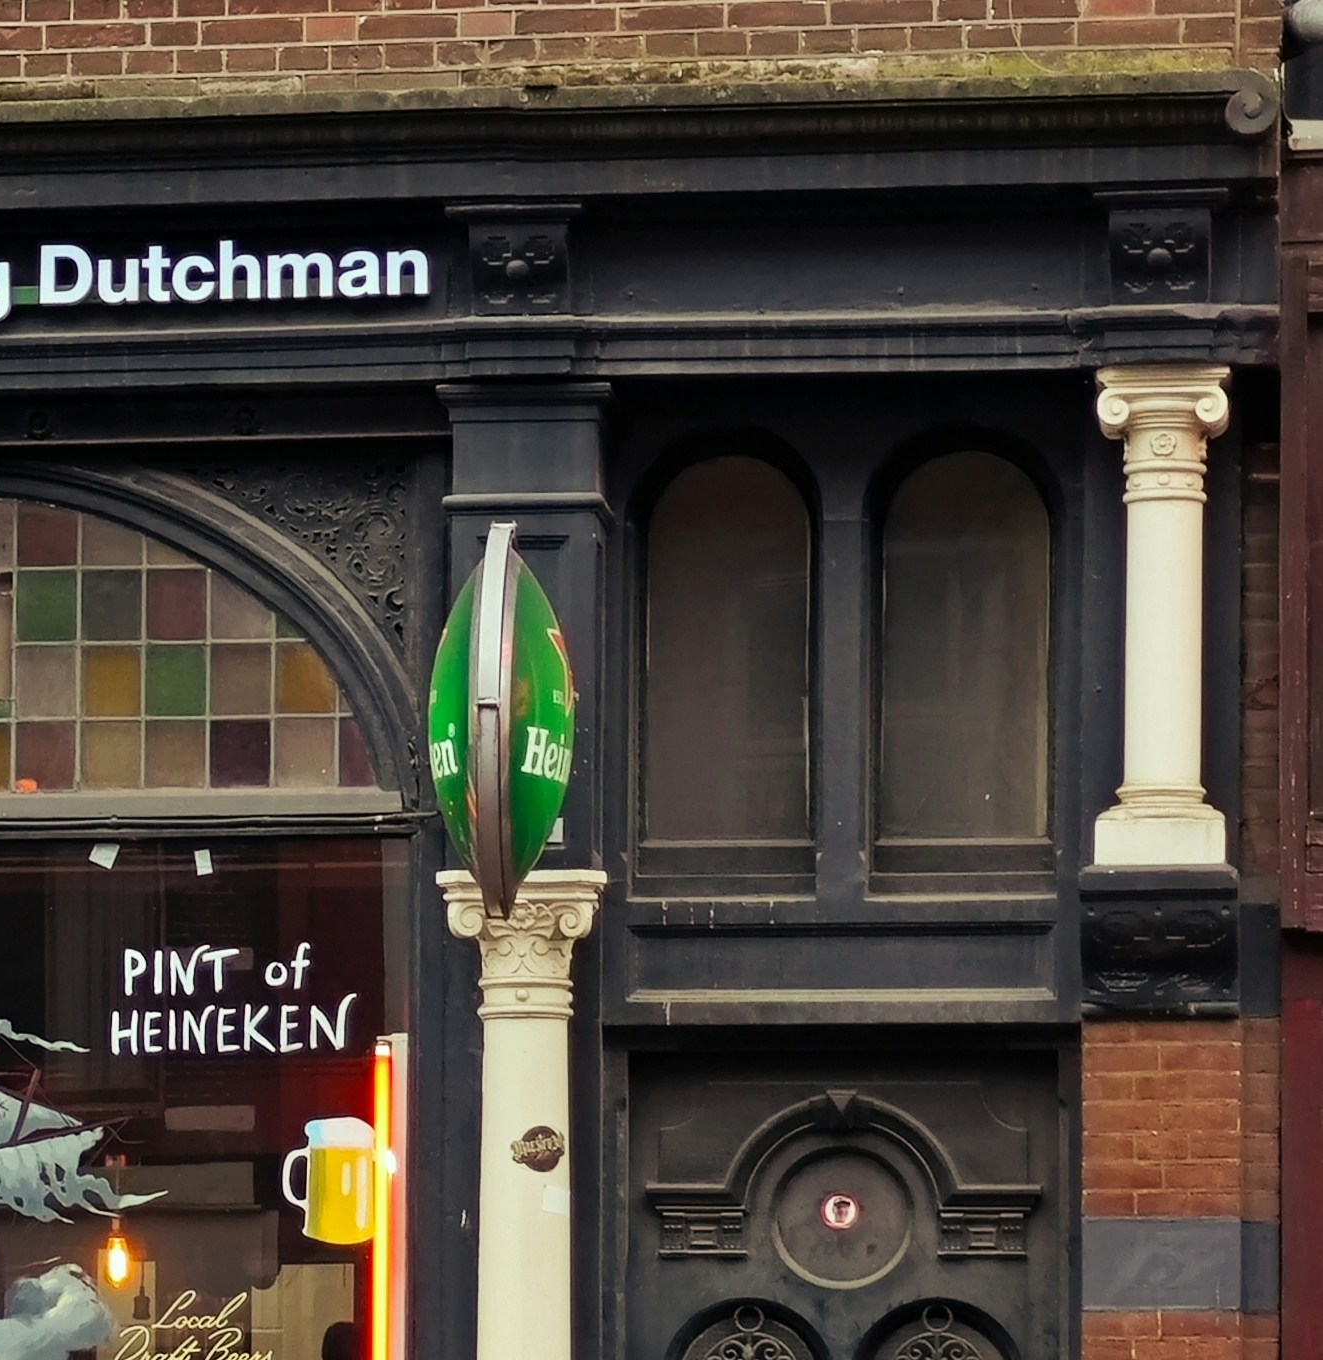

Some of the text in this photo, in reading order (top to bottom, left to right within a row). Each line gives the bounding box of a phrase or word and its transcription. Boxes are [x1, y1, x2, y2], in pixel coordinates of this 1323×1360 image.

[39, 240, 431, 307] Dutchman
[430, 739, 459, 780] en
[123, 942, 312, 997] PINT of
[110, 993, 358, 1057] HEINEKEN
[151, 1289, 248, 1329] Local
